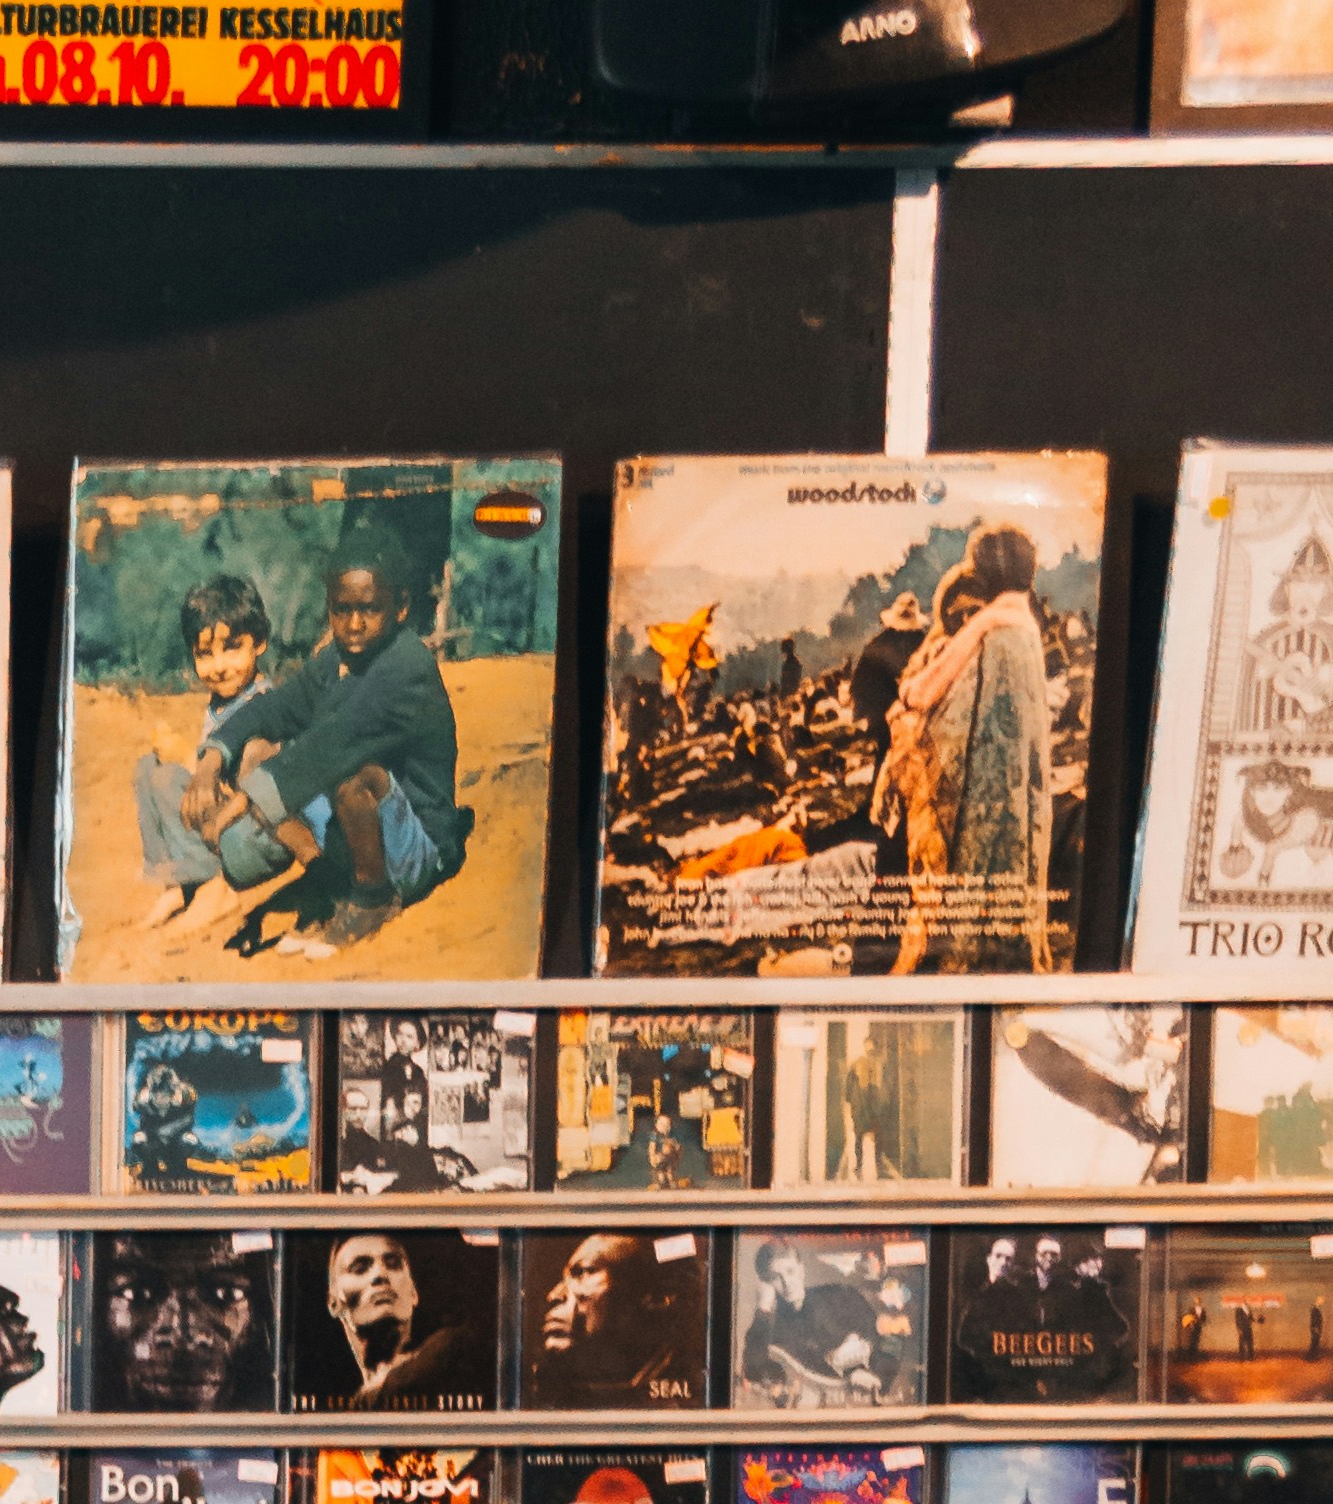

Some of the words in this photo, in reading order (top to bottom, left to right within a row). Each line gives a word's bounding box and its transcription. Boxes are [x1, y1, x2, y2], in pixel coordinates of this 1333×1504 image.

[220, 7, 402, 41] KESSELHAUS
[236, 43, 400, 108] 20:00
[1179, 922, 1284, 958] TRIO
[648, 1379, 692, 1399] SEAL
[101, 1466, 179, 1503] Bon
[330, 1479, 406, 1499] BON
[407, 1478, 480, 1501] JOVI
